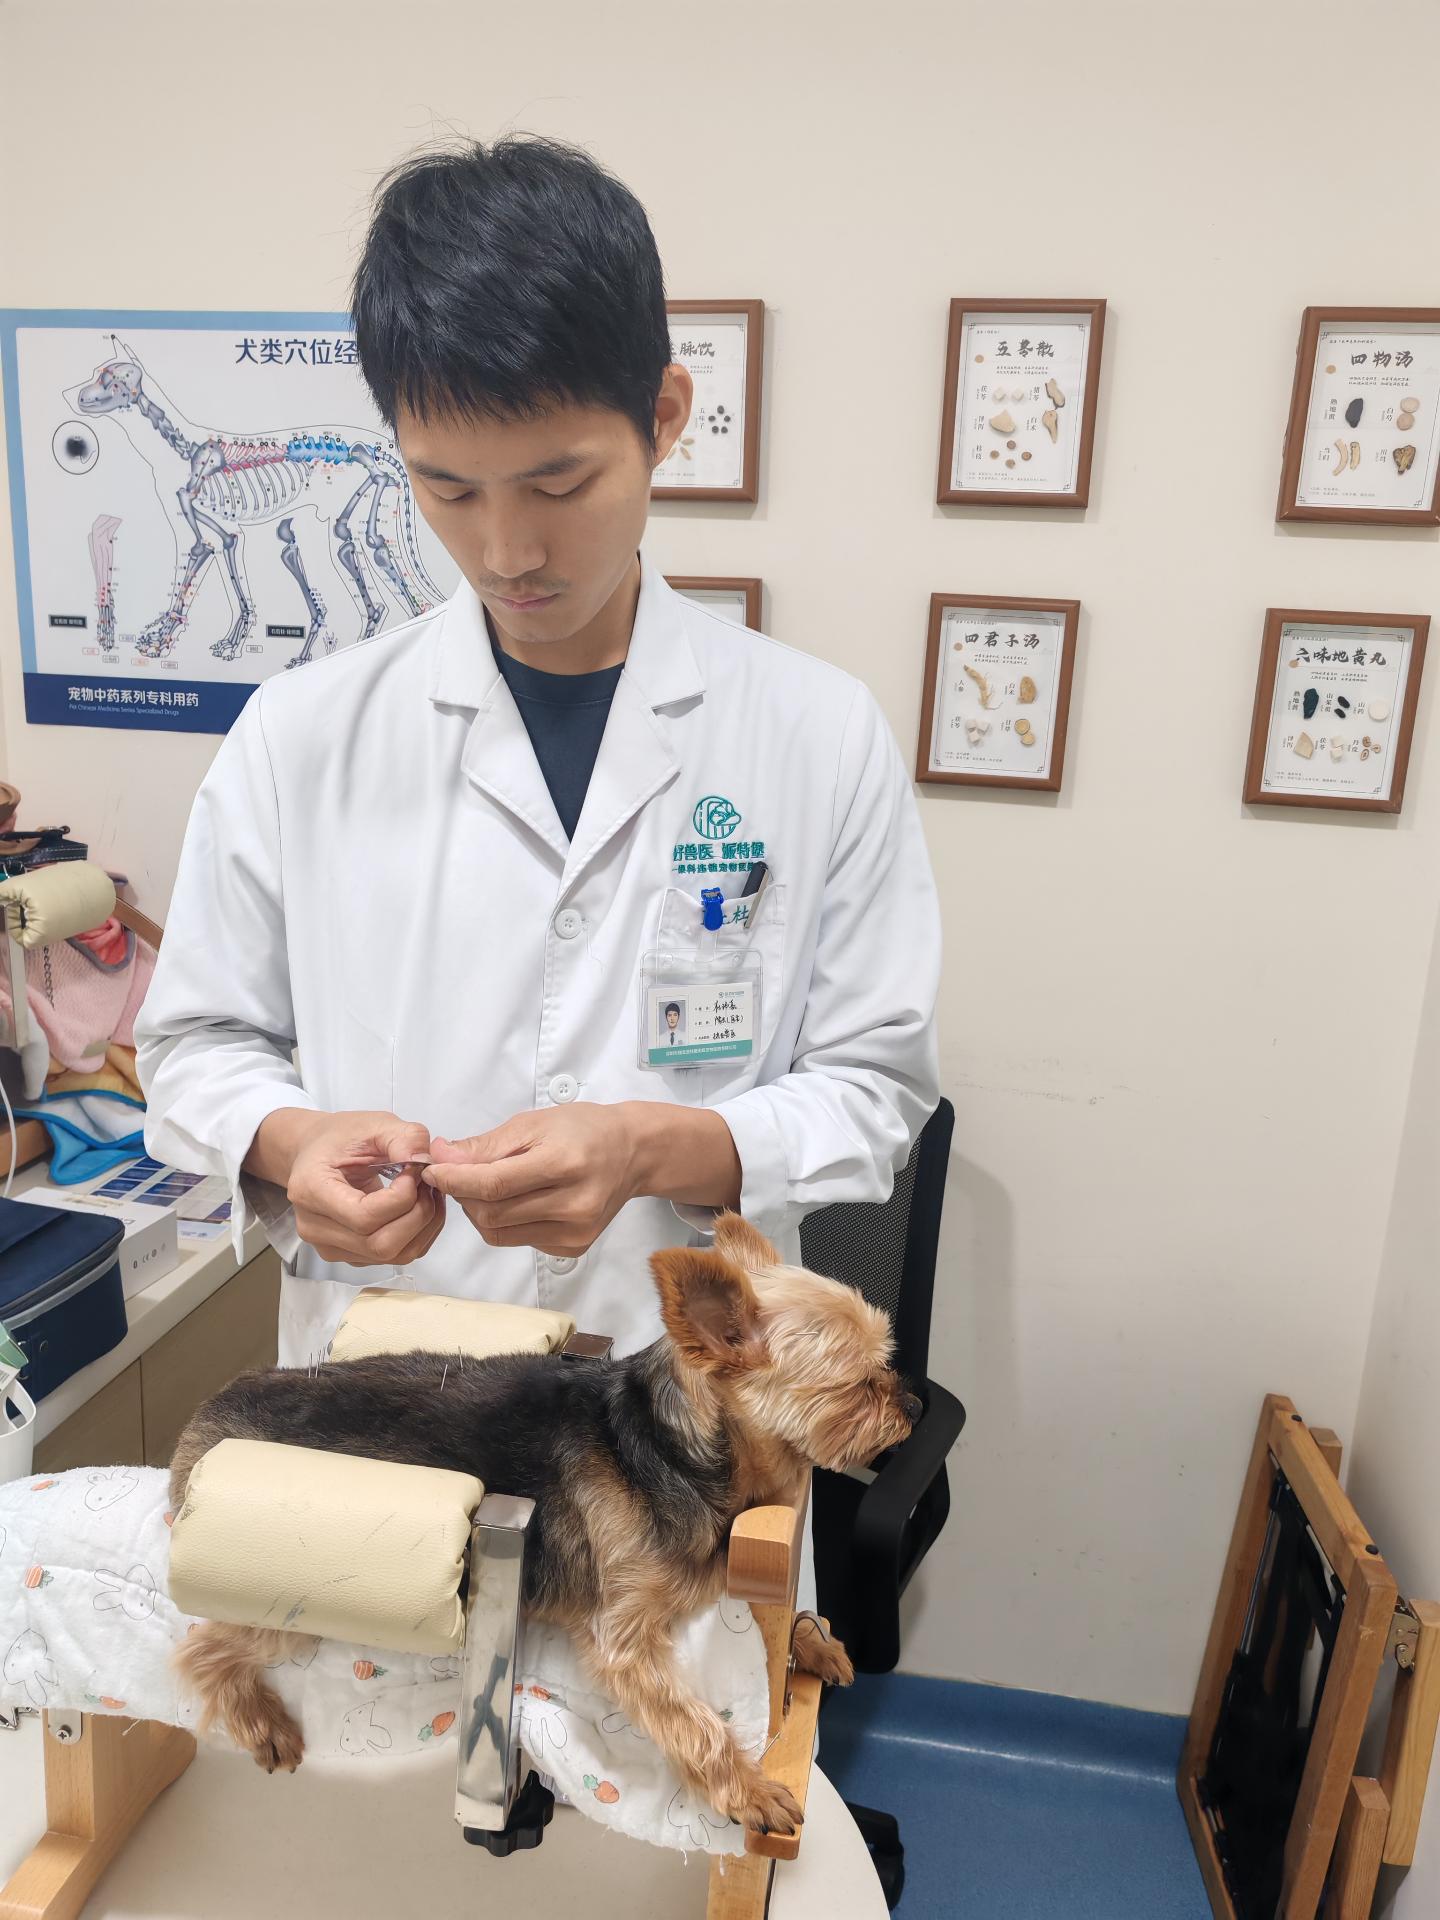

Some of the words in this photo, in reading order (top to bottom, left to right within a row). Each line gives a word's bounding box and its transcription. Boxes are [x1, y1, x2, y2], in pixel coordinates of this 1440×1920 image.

[235, 338, 358, 366] 犬类穴位经
[995, 339, 1054, 358] 五苓散
[1350, 350, 1414, 369] 四物汤
[964, 631, 1040, 649] 四君子汤
[1295, 646, 1387, 666] 六味地黄丸
[68, 687, 199, 707] 宠物中药系列专科用药
[164, 708, 179, 716] Drugs
[722, 841, 765, 859] 派特堡
